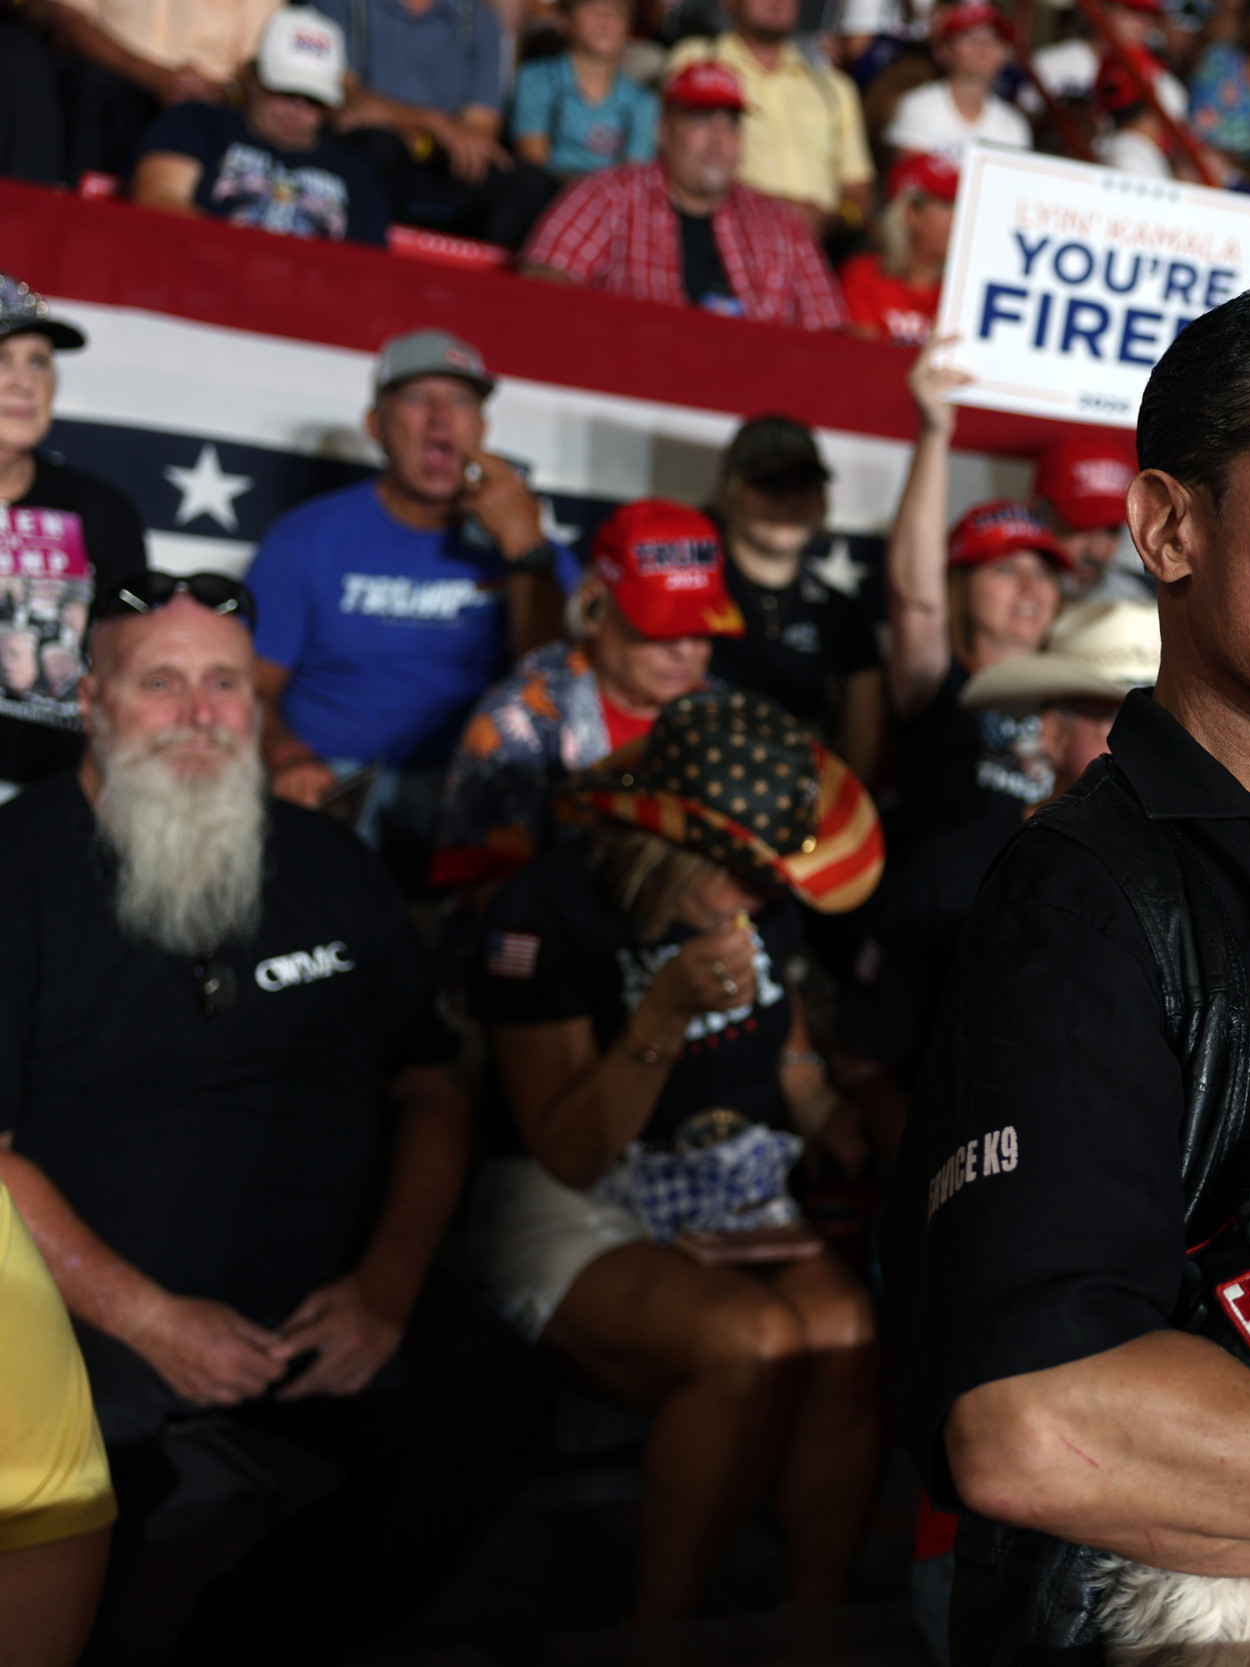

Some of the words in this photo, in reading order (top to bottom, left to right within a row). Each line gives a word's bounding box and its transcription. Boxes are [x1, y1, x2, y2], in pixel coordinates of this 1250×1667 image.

[1013, 229, 1237, 308] YOU'RE
[1105, 214, 1242, 262] KAMALA
[977, 282, 1195, 367] FIRE
[983, 1125, 1019, 1176] K9
